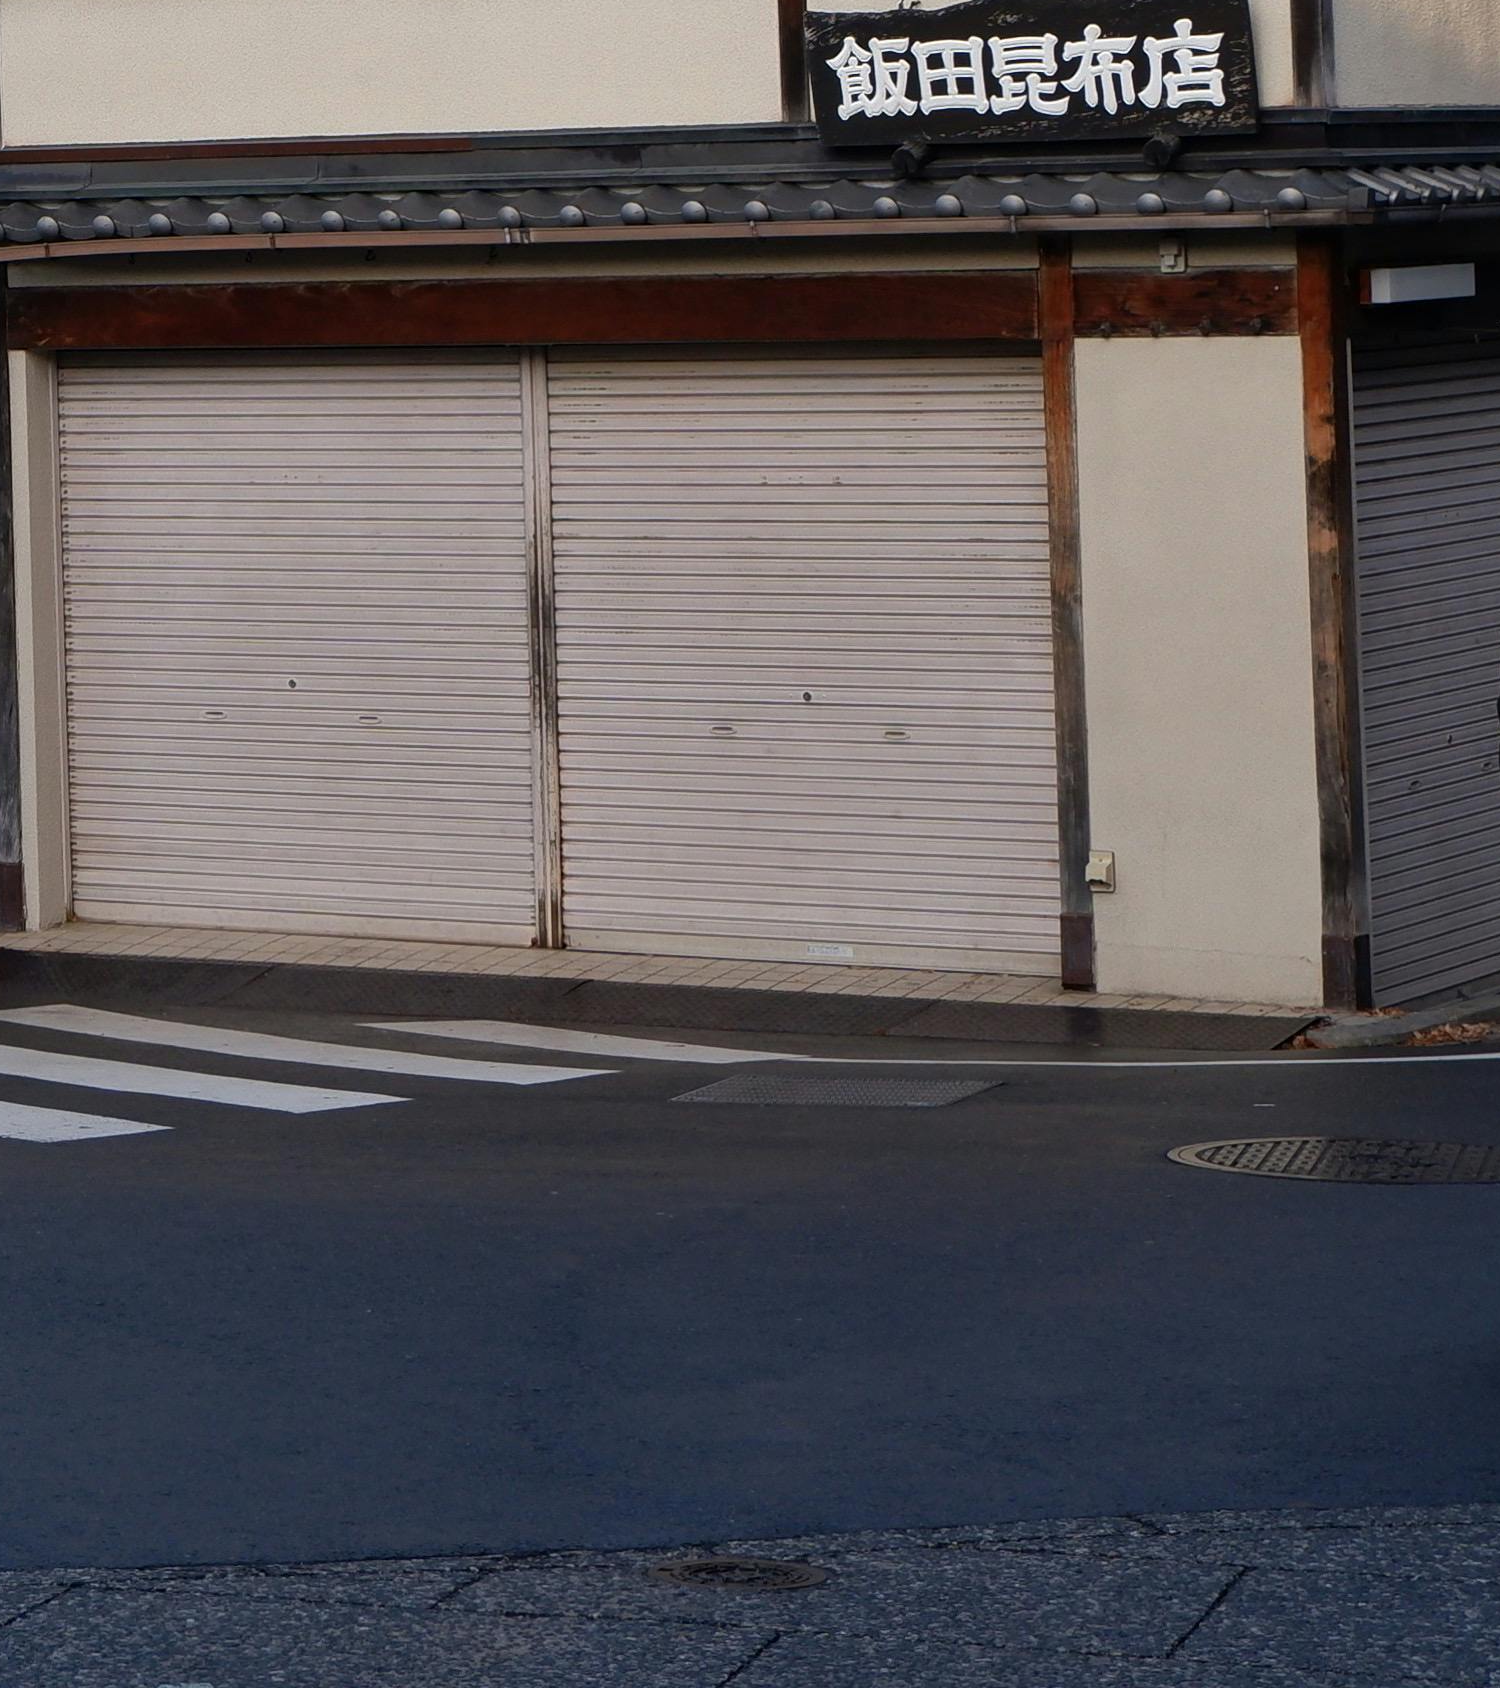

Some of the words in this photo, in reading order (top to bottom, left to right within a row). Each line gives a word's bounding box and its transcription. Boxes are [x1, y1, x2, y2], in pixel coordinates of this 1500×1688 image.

[825, 17, 1227, 121] 飯田昆布店
